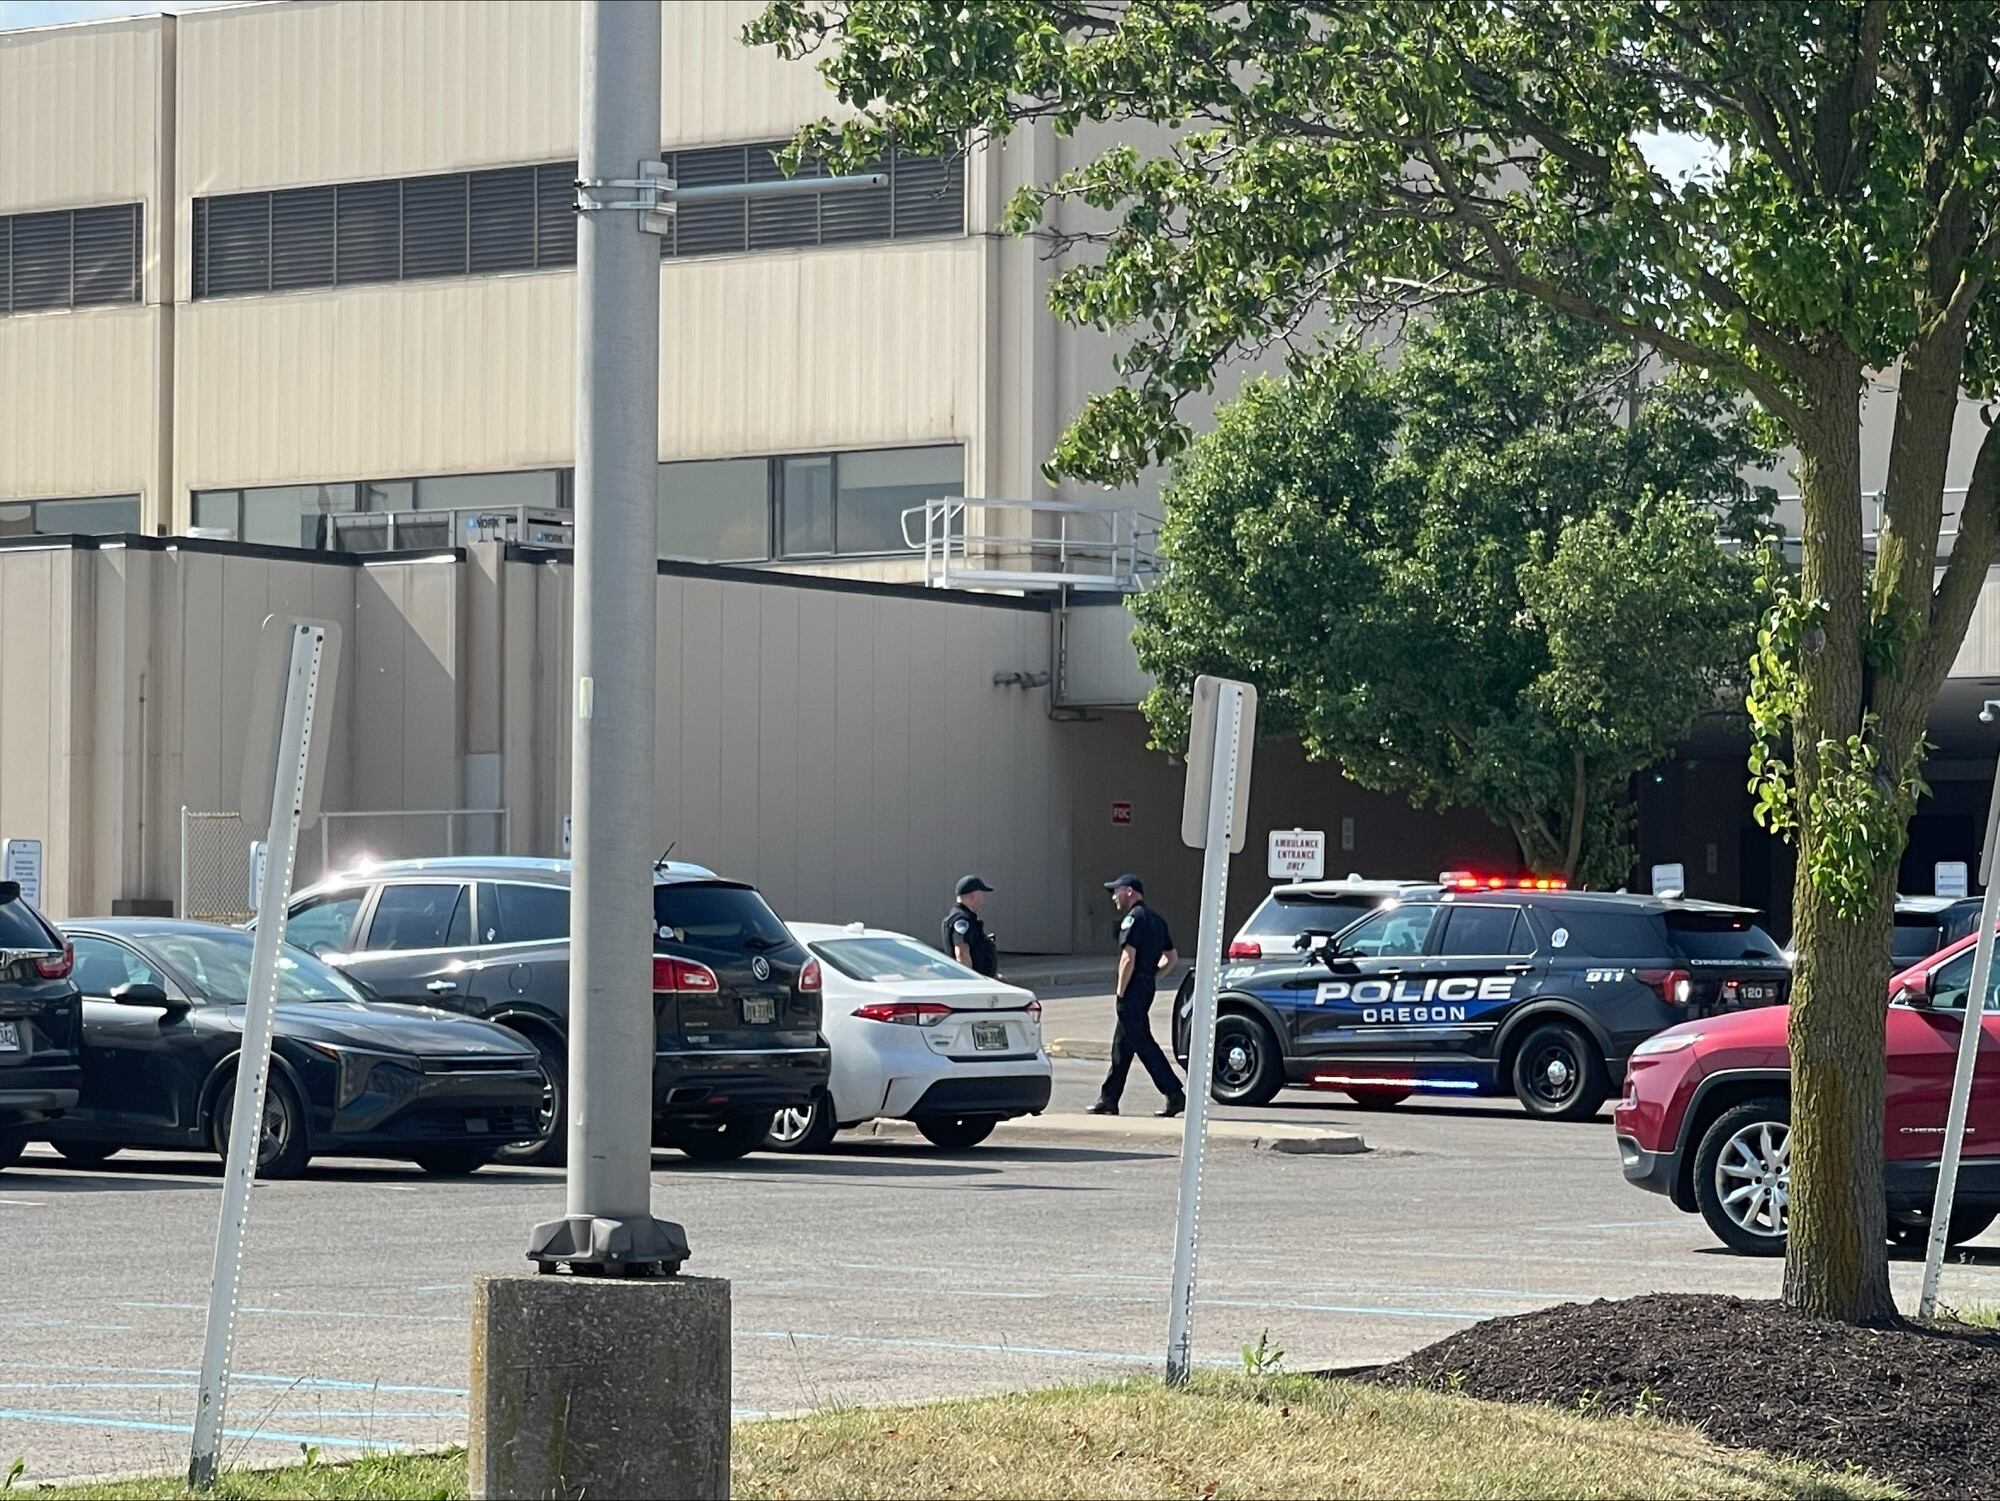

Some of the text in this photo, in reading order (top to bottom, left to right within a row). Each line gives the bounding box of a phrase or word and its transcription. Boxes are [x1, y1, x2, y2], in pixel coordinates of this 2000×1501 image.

[1274, 839, 1319, 849] AMBULANCE
[1277, 850, 1316, 860] ENTRANCE
[1286, 861, 1305, 871] ONLY
[1690, 959, 1748, 967] OREGON
[1585, 971, 1625, 982] 911
[1315, 977, 1517, 1005] POLICE
[1741, 987, 1763, 999] 120
[1362, 1006, 1465, 1023] OREGON
